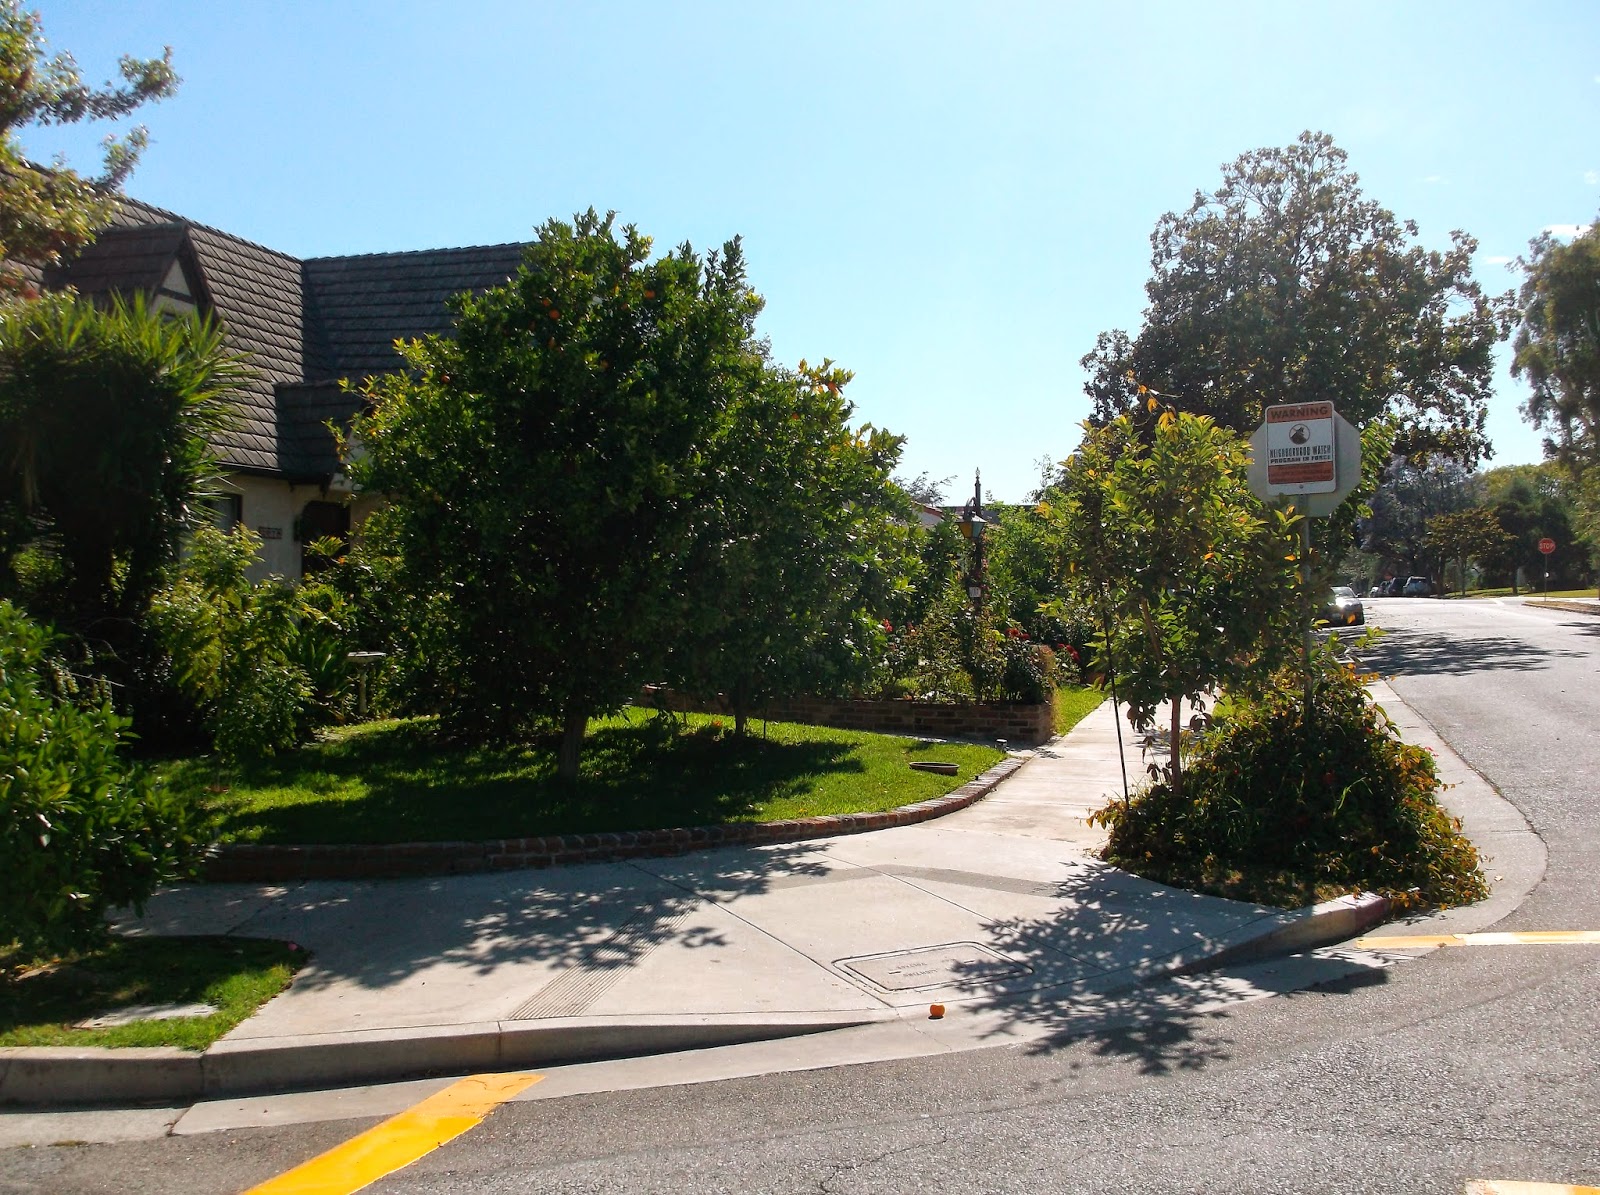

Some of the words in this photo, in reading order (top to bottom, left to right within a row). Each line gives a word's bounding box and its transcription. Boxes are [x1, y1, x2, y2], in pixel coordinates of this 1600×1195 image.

[1270, 406, 1327, 419] WARNING
[1270, 447, 1310, 457] NEIGHBORHOOD
[1312, 445, 1331, 455] WATCH
